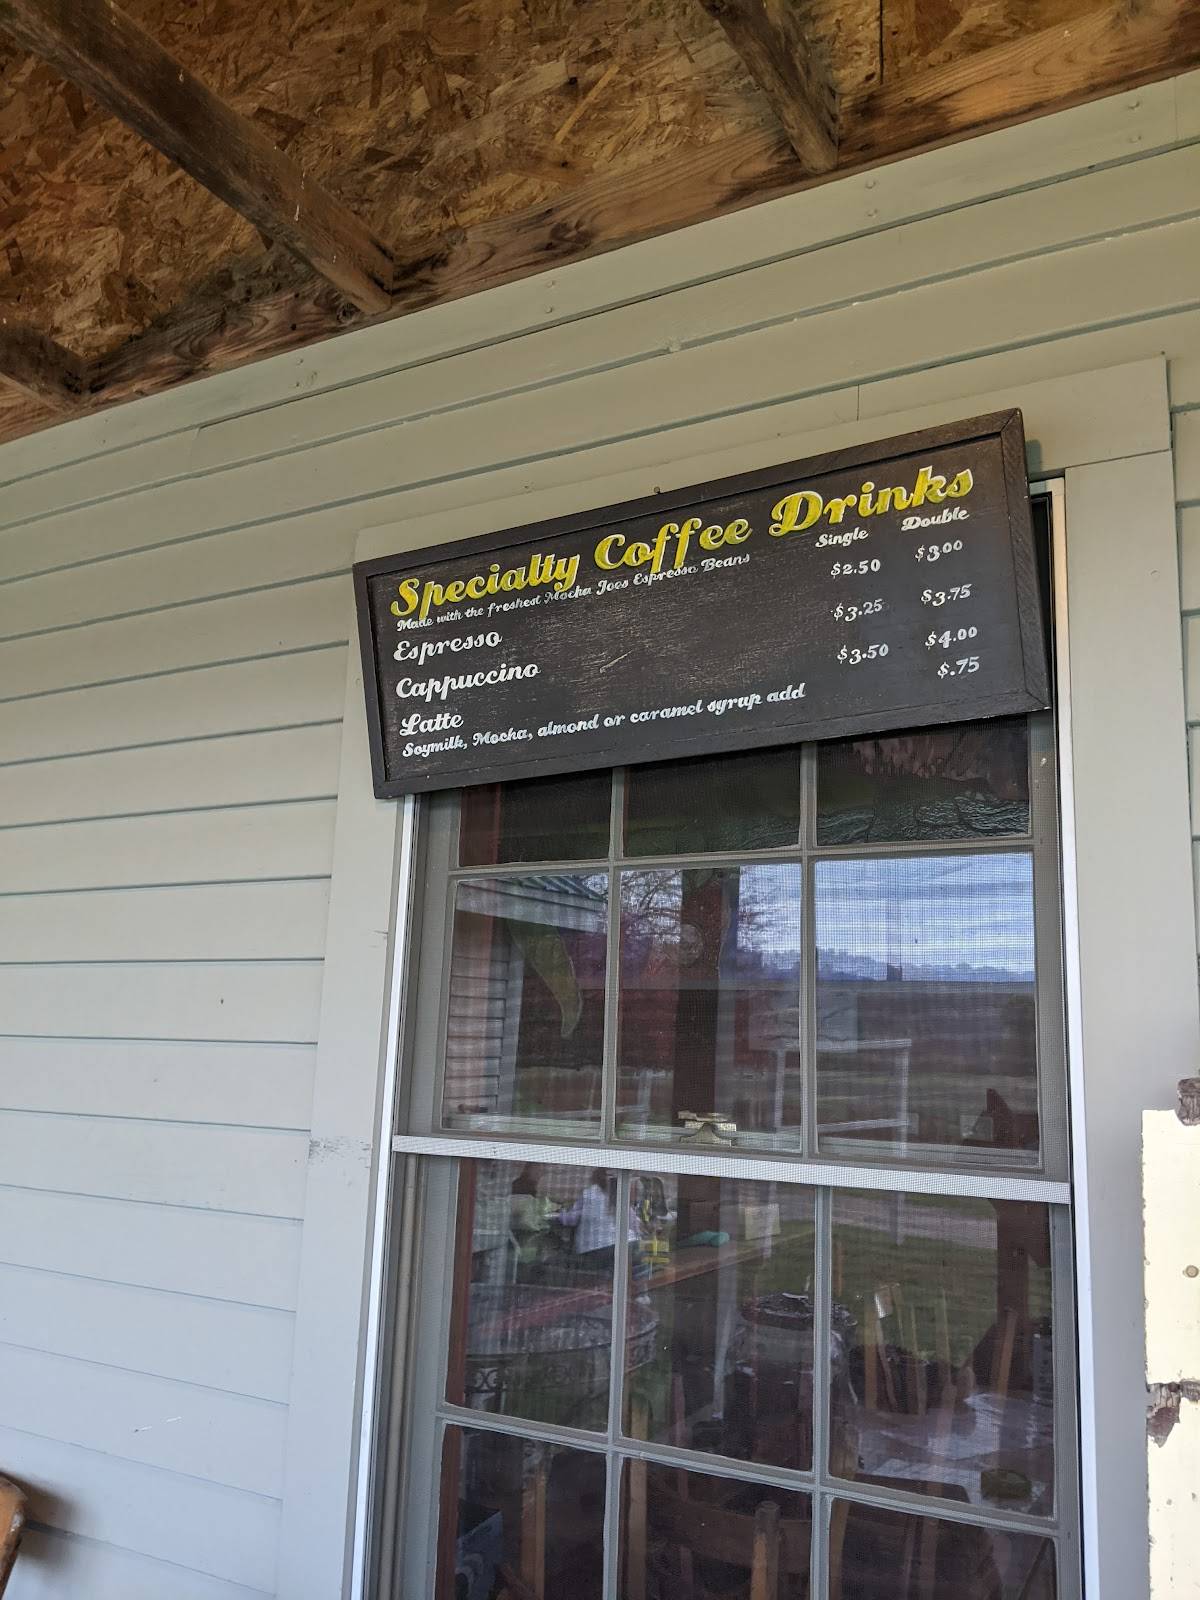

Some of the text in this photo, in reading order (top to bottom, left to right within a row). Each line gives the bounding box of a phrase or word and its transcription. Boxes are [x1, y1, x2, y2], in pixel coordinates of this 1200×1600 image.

[901, 507, 970, 531] Double
[391, 465, 974, 620] Specialty Coffee Drinks
[815, 526, 869, 548] Single
[915, 540, 963, 562] $3.00
[831, 559, 881, 579] $2.50
[397, 553, 750, 632] Made with the freshest Mocha Joes Espresso Beans
[921, 584, 972, 606] $3.75
[833, 599, 883, 621] $3.25
[393, 631, 502, 666] Espresso
[925, 626, 978, 649] $4.00
[837, 643, 889, 664] $3.50
[937, 656, 980, 679] $.75
[396, 663, 541, 702] Cappuccino
[400, 713, 464, 737] Latte
[402, 682, 806, 757] Soymilk, Mocha, almond or caramel syrup add
